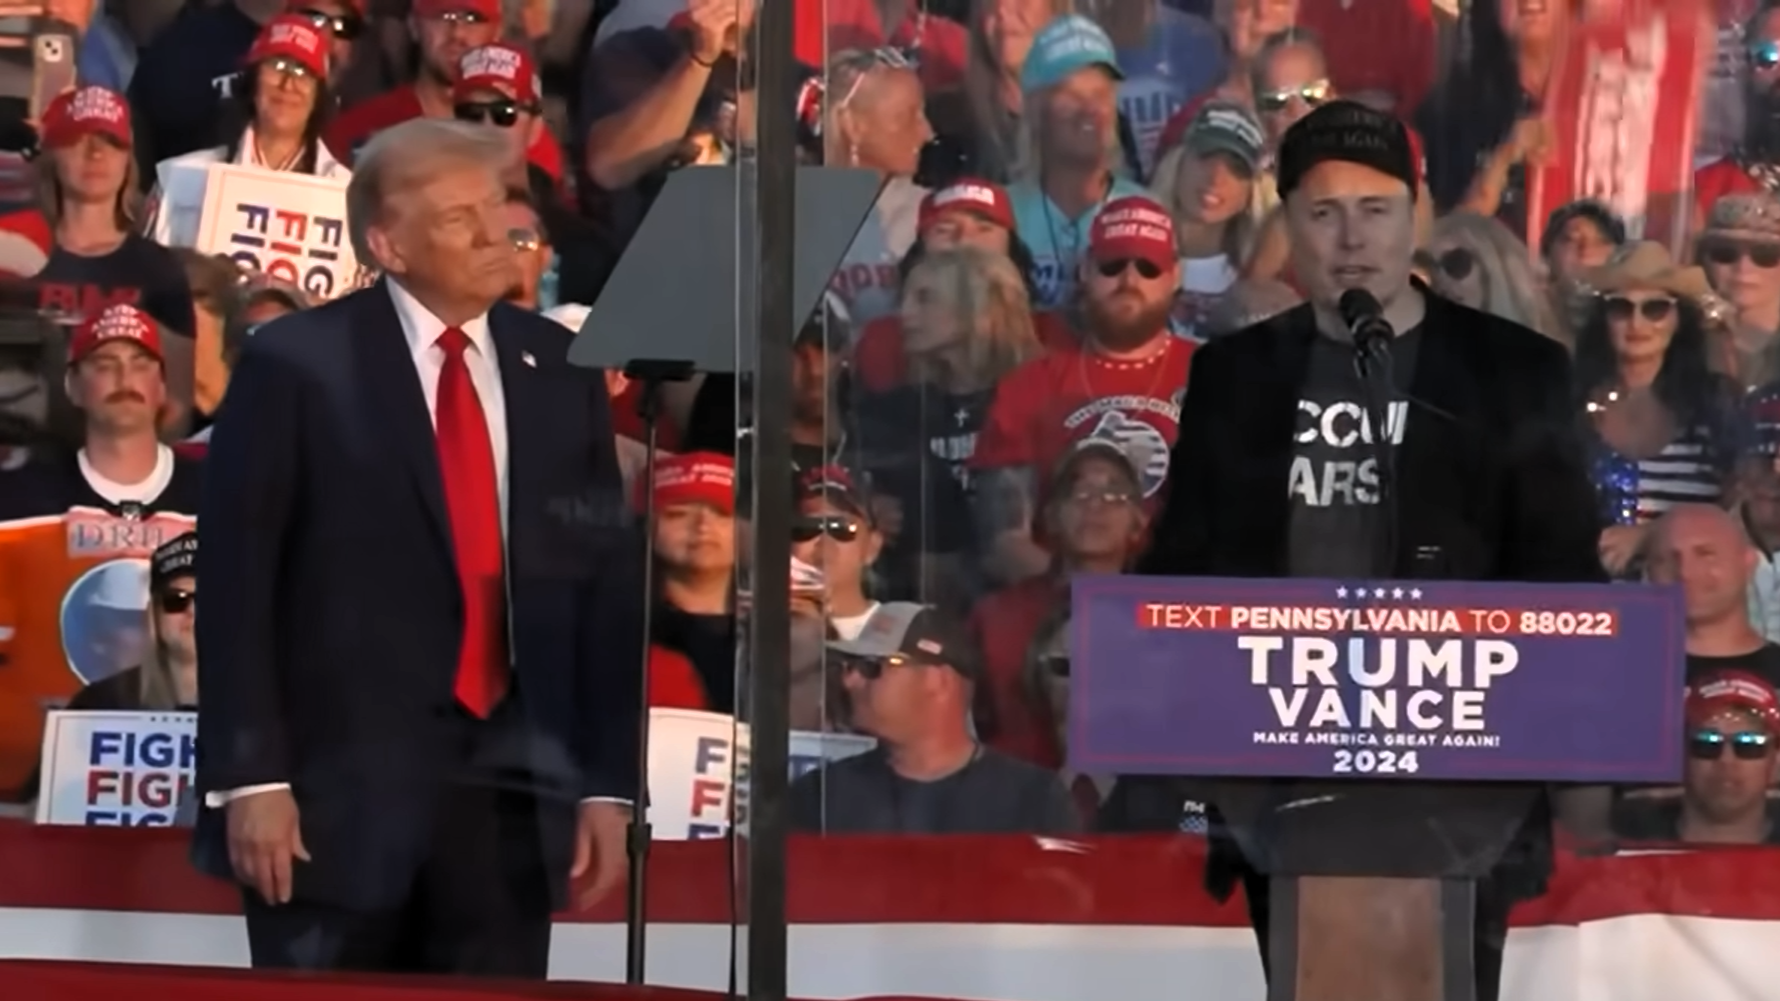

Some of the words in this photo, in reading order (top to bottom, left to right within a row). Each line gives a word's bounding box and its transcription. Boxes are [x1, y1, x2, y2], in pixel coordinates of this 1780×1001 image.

[1147, 604, 1221, 628] TEXT
[1231, 606, 1461, 632] PENNSYLVANIA
[1469, 609, 1510, 634] TO
[1519, 611, 1612, 635] 88022
[1237, 636, 1519, 688] TRUMP
[1268, 687, 1485, 730] VANCE
[1253, 732, 1299, 745] MAKE
[1304, 733, 1379, 746] AMERICA
[1383, 734, 1437, 747] GREAT
[1442, 735, 1500, 747] AGAIN!
[1333, 750, 1418, 773] 2024
